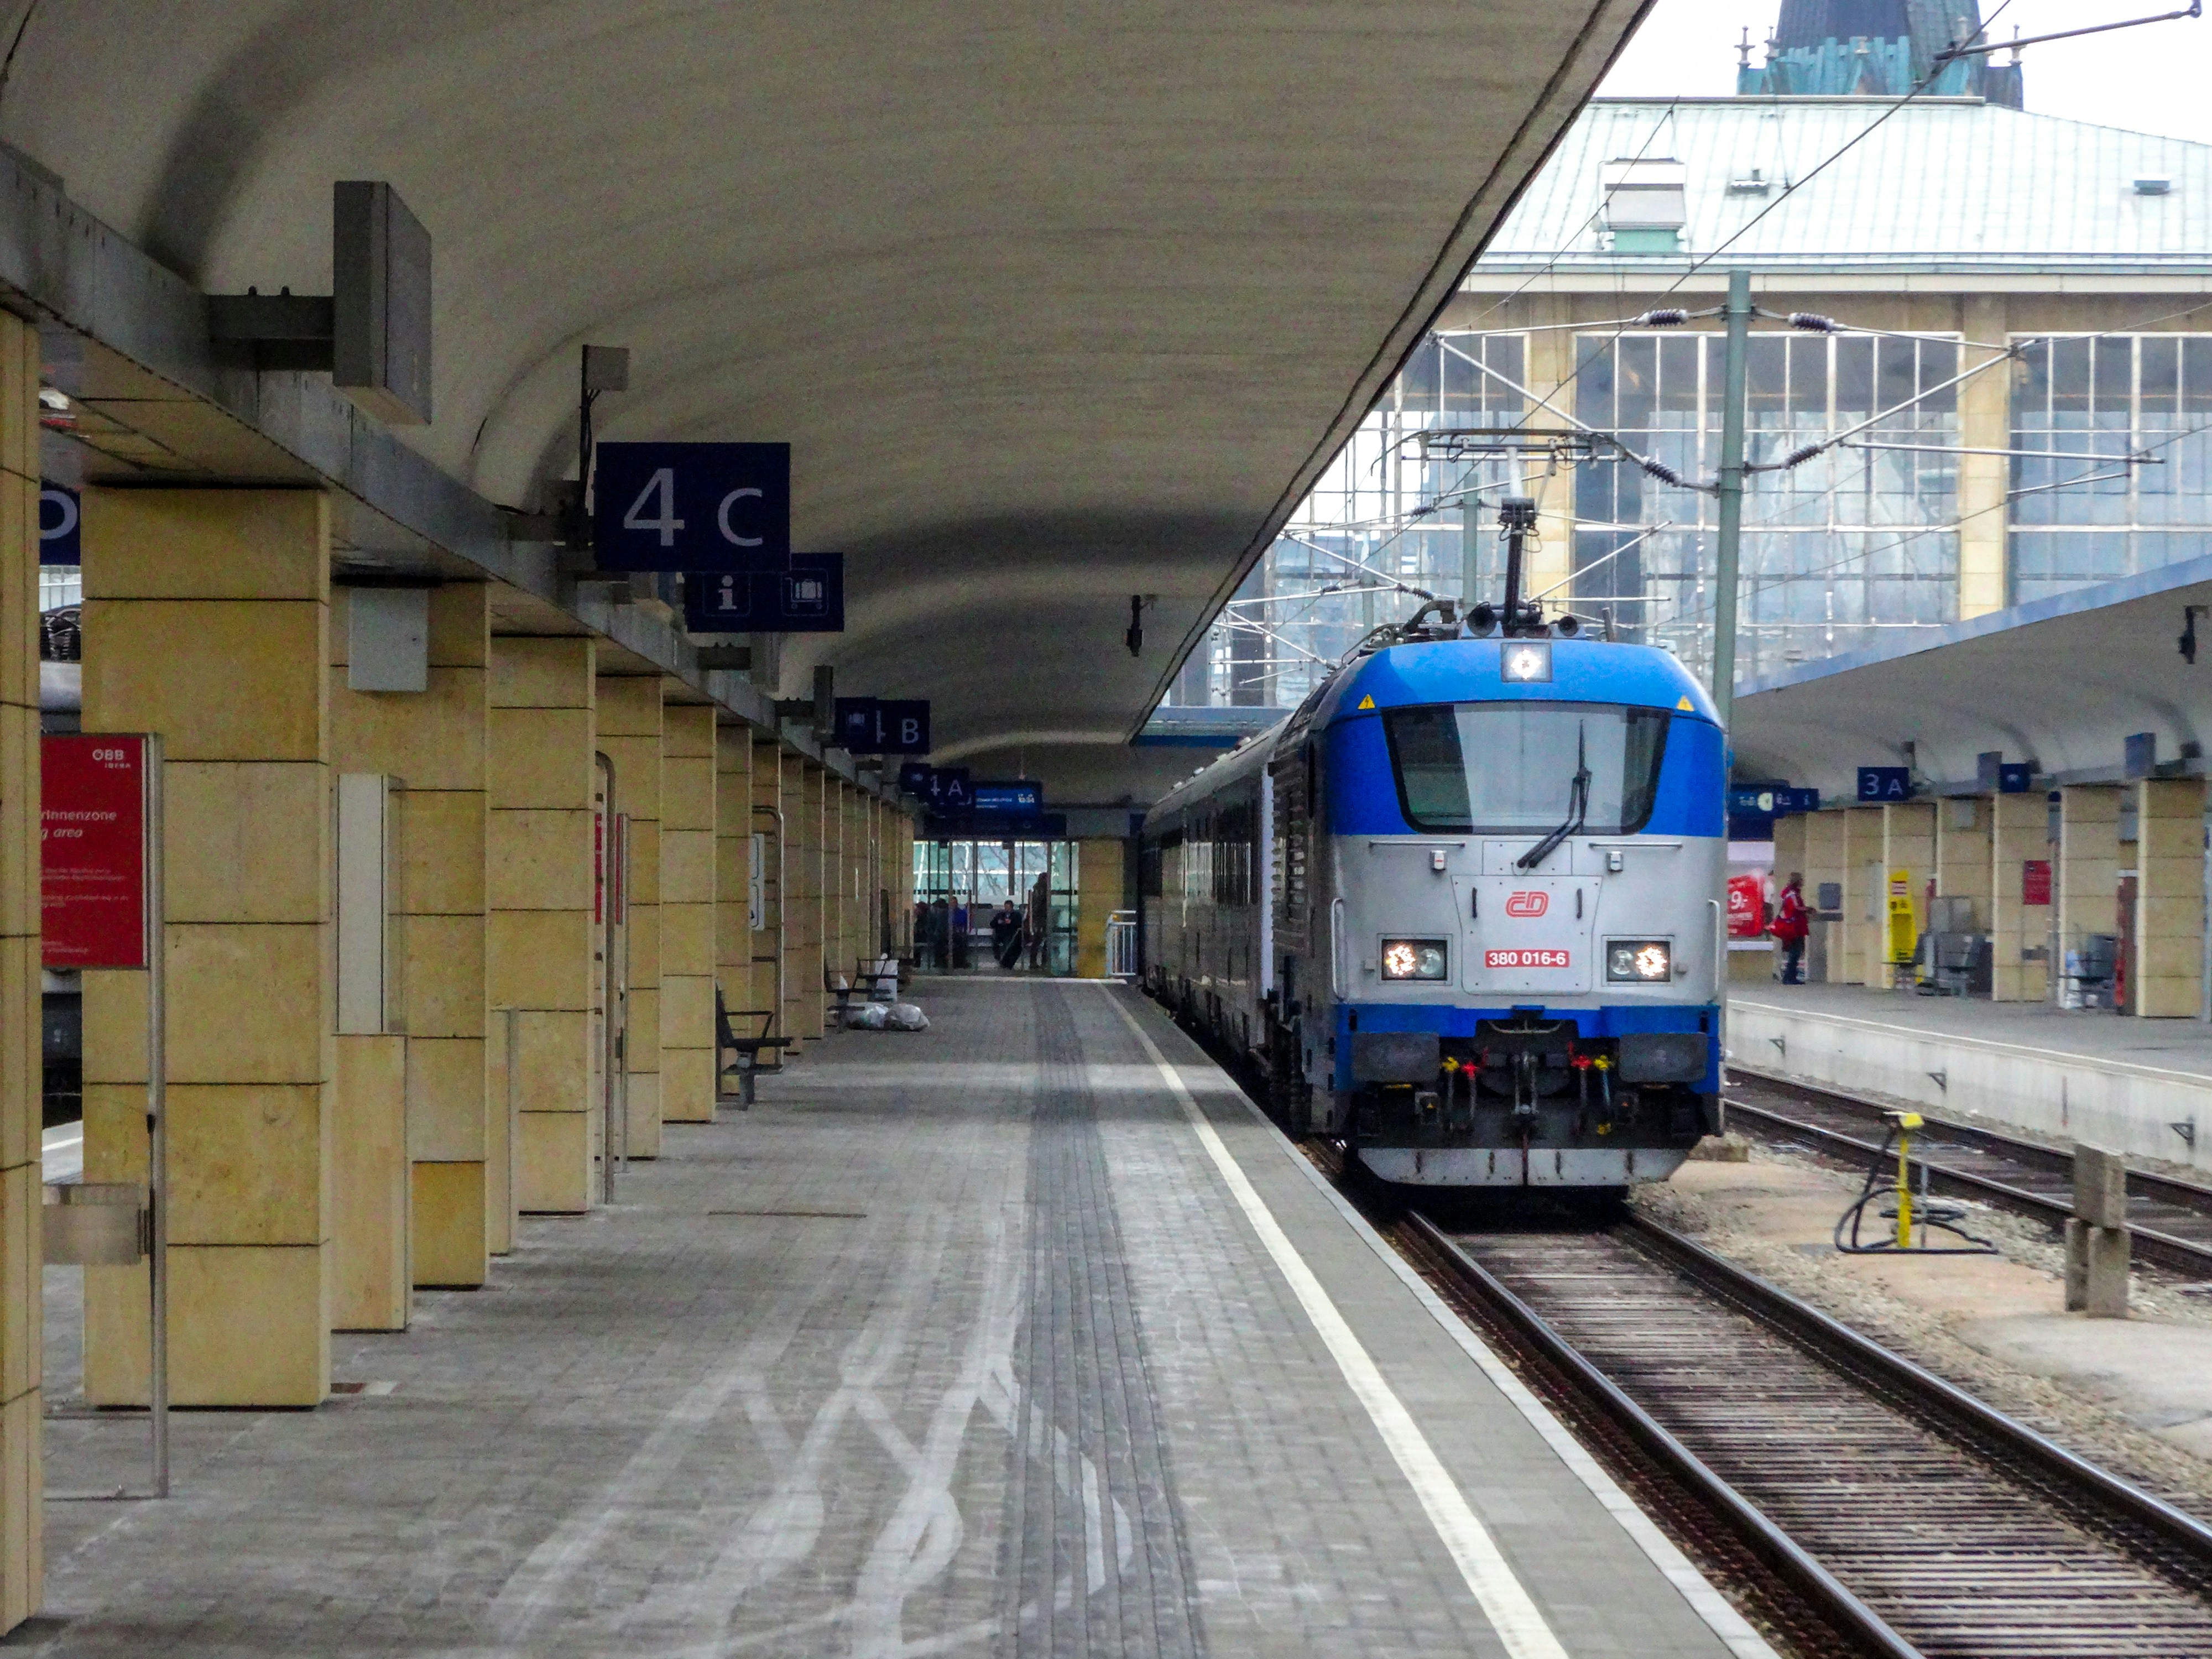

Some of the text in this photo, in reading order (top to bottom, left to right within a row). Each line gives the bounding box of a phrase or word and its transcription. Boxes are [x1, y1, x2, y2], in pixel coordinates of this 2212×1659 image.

[623, 468, 763, 546] 4 C
[901, 718, 919, 744] B
[948, 778, 963, 796] A
[1864, 774, 1903, 796] 3 A
[1489, 952, 1566, 966] 380 016-6
